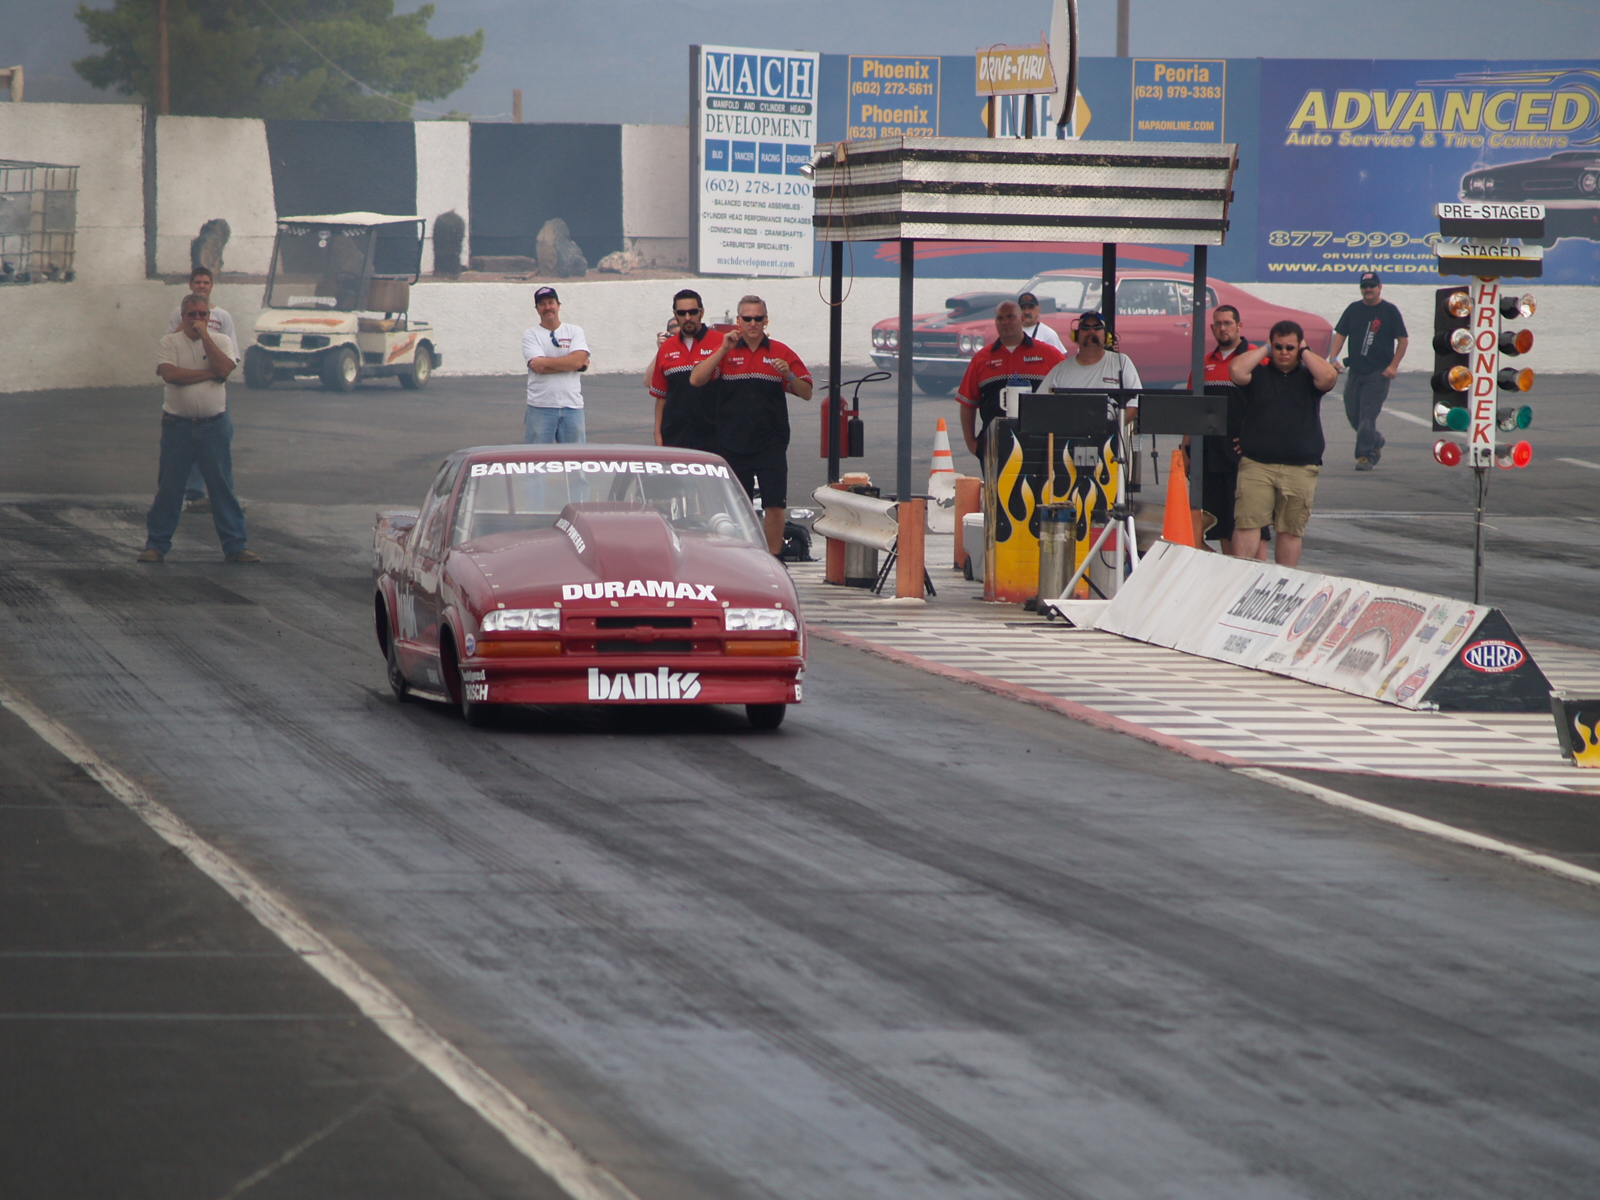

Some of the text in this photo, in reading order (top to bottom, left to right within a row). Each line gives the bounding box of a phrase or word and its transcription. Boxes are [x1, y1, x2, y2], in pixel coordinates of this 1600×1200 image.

[706, 54, 812, 97] MACH
[863, 60, 930, 79] Phoenix
[979, 54, 1047, 82] DRIVE-THRU
[1154, 64, 1209, 82] Peoria
[852, 82, 933, 96] (602) 272-5611
[1135, 85, 1222, 100] (623) 979-3363
[713, 100, 805, 113] MANIFOLD AND CYLINDER HEAD
[861, 105, 928, 124] Phoenix
[1288, 91, 1592, 132] ADVANCED
[706, 114, 812, 138] DEVELOPMENT
[849, 126, 935, 140] (623) 850-6272
[1138, 121, 1214, 131] NAPAONLINE.COM
[1286, 132, 1569, 148] Auto Service & Tire Centers
[712, 150, 809, 163] BUD YANCER RACING ENGINES
[705, 178, 811, 196] (602) 278-1200
[714, 199, 800, 210] BALANCED ROTATING ASSEMBLIES
[1443, 205, 1541, 219] PRE-STAGED
[703, 212, 727, 220] CYLINDER
[744, 214, 782, 223] PERFORMANCE
[784, 216, 811, 225] PACKAGES
[710, 226, 803, 238] CONNECTING RODS CRANKSHAFTS
[722, 240, 789, 251] CARBURETOR SPECIALISTS
[1460, 245, 1521, 257] STAGED
[717, 256, 795, 268] machdevelopment.com
[1472, 277, 1498, 444] HRONDEK
[470, 461, 730, 479] BANKSPOWER.COM
[566, 525, 586, 554] POWERED
[562, 580, 717, 601] DURAMAX
[1227, 573, 1306, 627] AutoTrader
[1470, 645, 1518, 667] NHRA
[465, 684, 489, 700] BOSCH
[588, 667, 701, 700] banks
